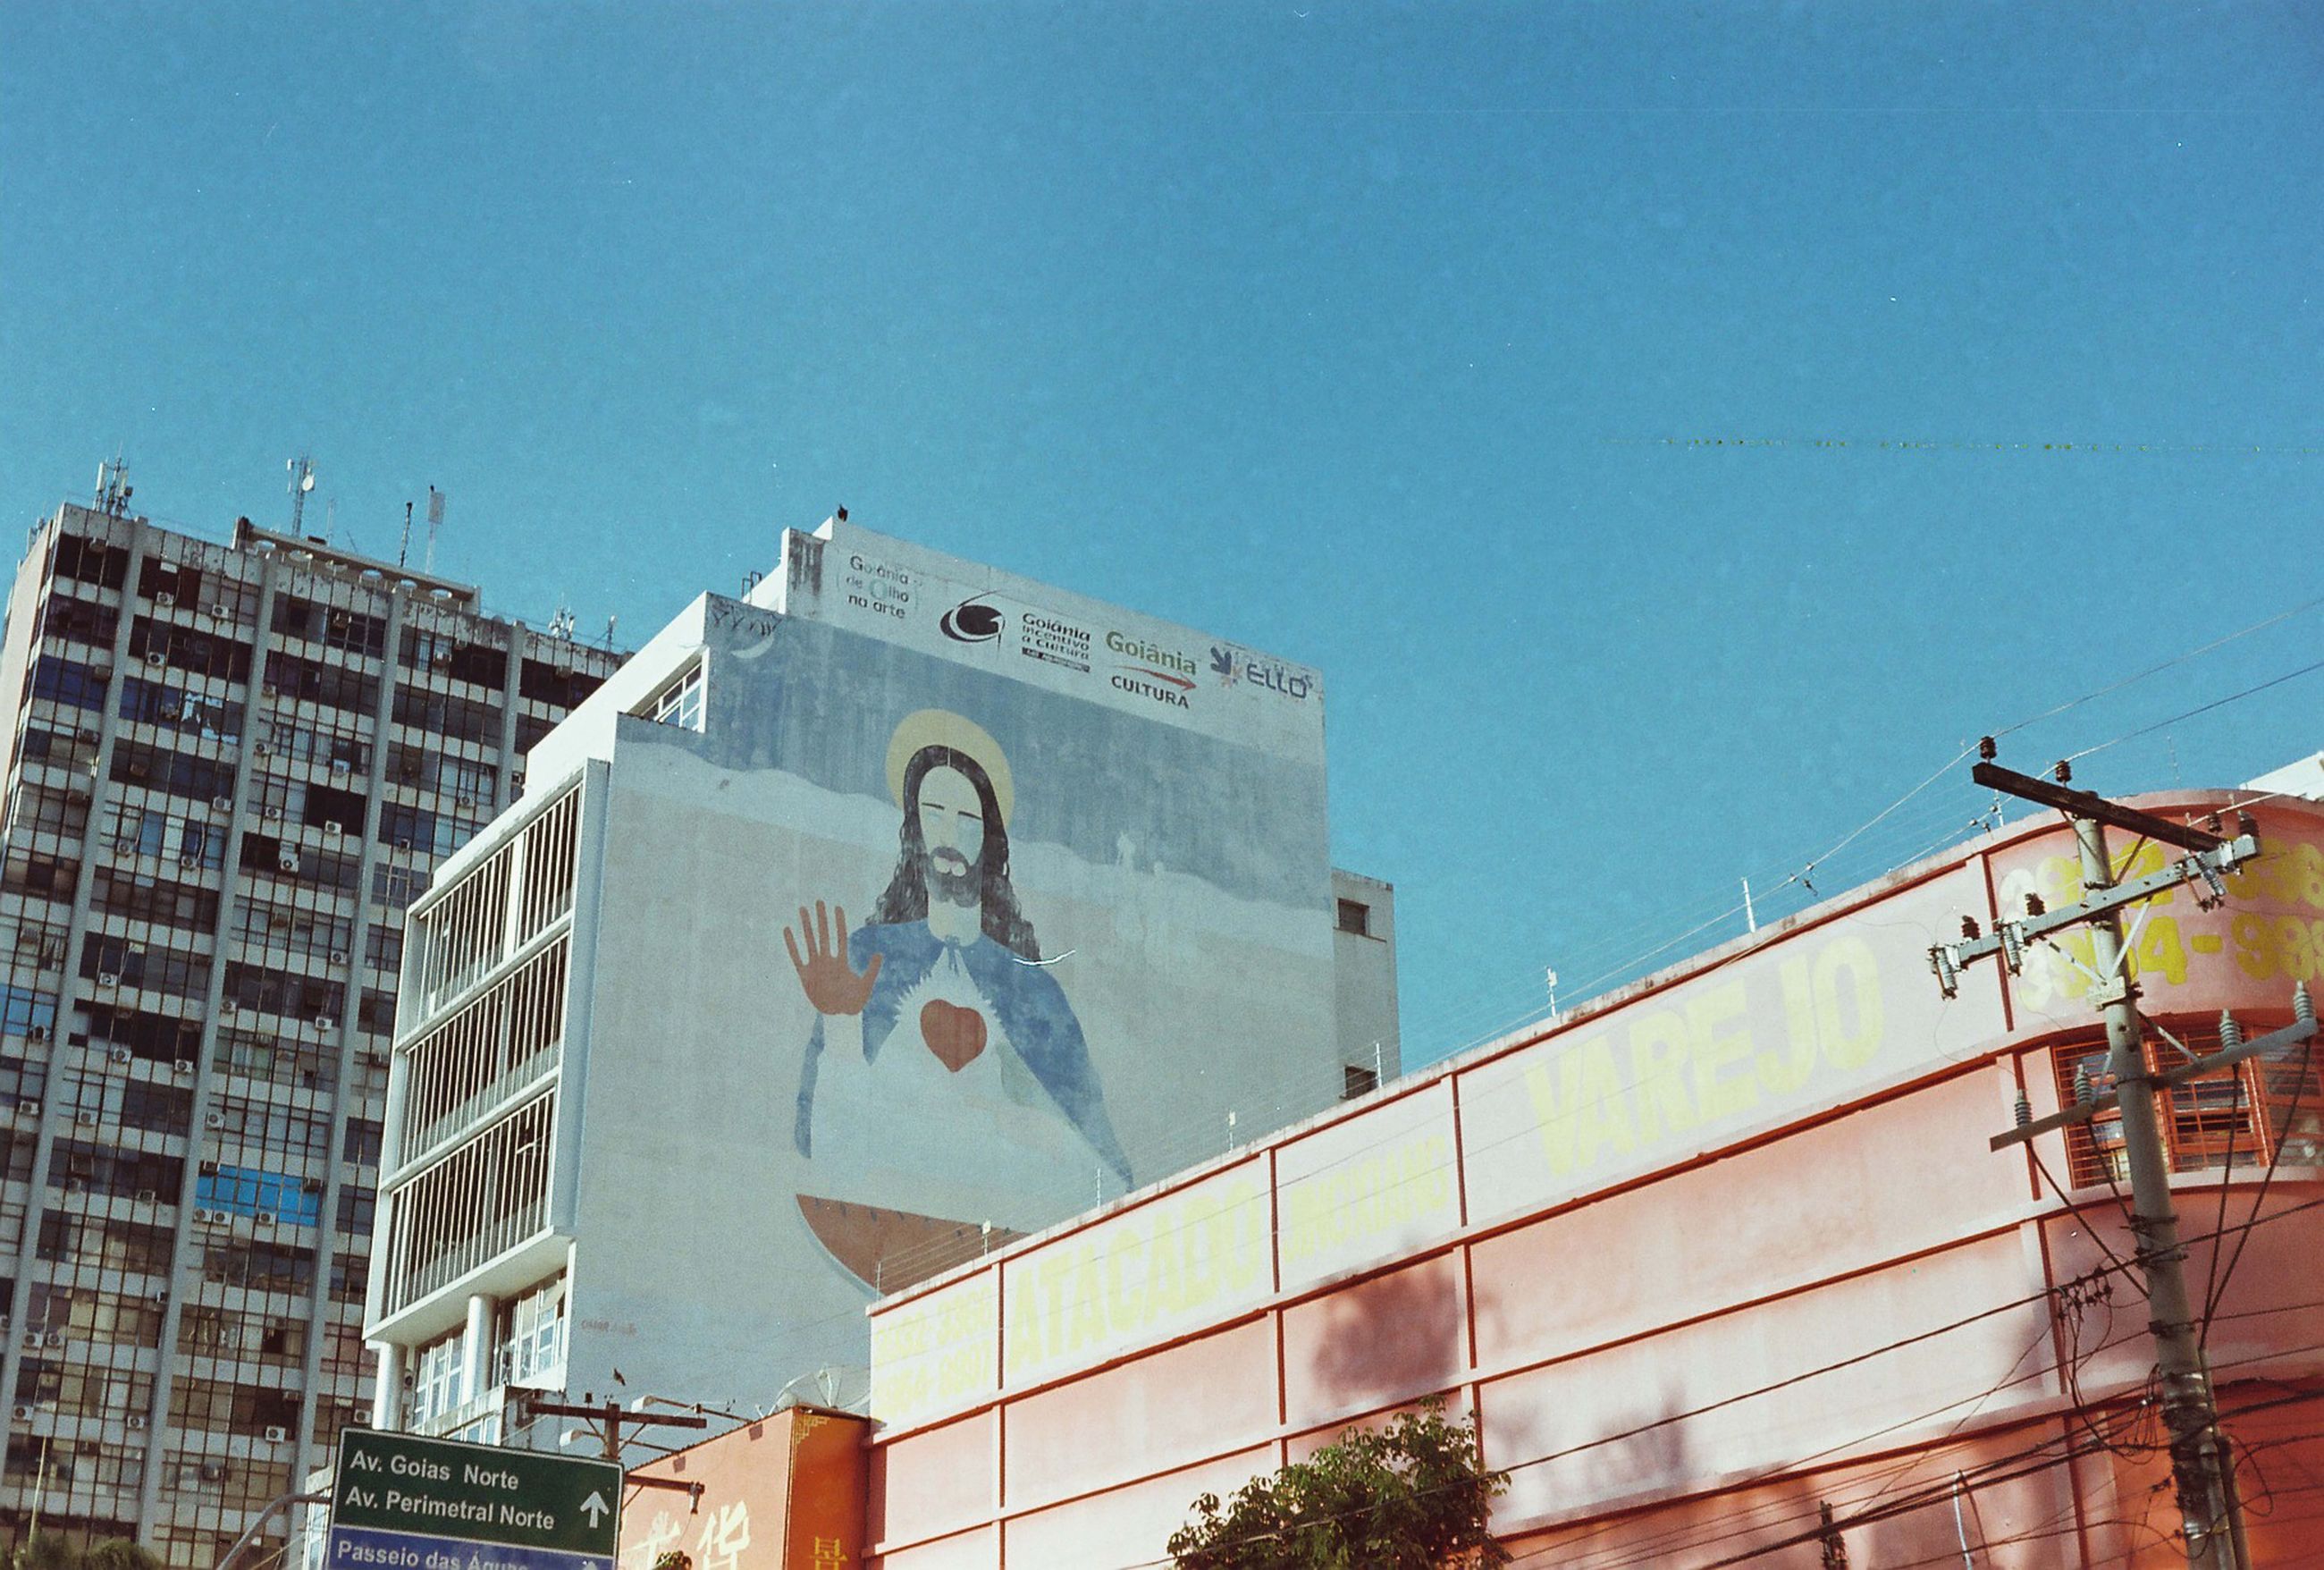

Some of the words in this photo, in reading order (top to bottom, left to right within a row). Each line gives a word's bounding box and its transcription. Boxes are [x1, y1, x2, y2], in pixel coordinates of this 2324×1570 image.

[850, 555, 909, 585] Goânia
[848, 595, 868, 608] na
[873, 602, 905, 619] arte
[1106, 631, 1196, 675] Goiânia
[1111, 675, 1189, 709] CULTURA
[1006, 1180, 1262, 1375] ATACADO
[1525, 939, 1886, 1178] VAREJO
[349, 1449, 383, 1473] Av.
[390, 1454, 451, 1481] Goias
[462, 1464, 520, 1491] Norte
[344, 1486, 378, 1509] Av.
[385, 1490, 494, 1523] Perimetral
[499, 1506, 555, 1532] Norte
[337, 1540, 419, 1566] Passeio
[425, 1551, 461, 1570] das
